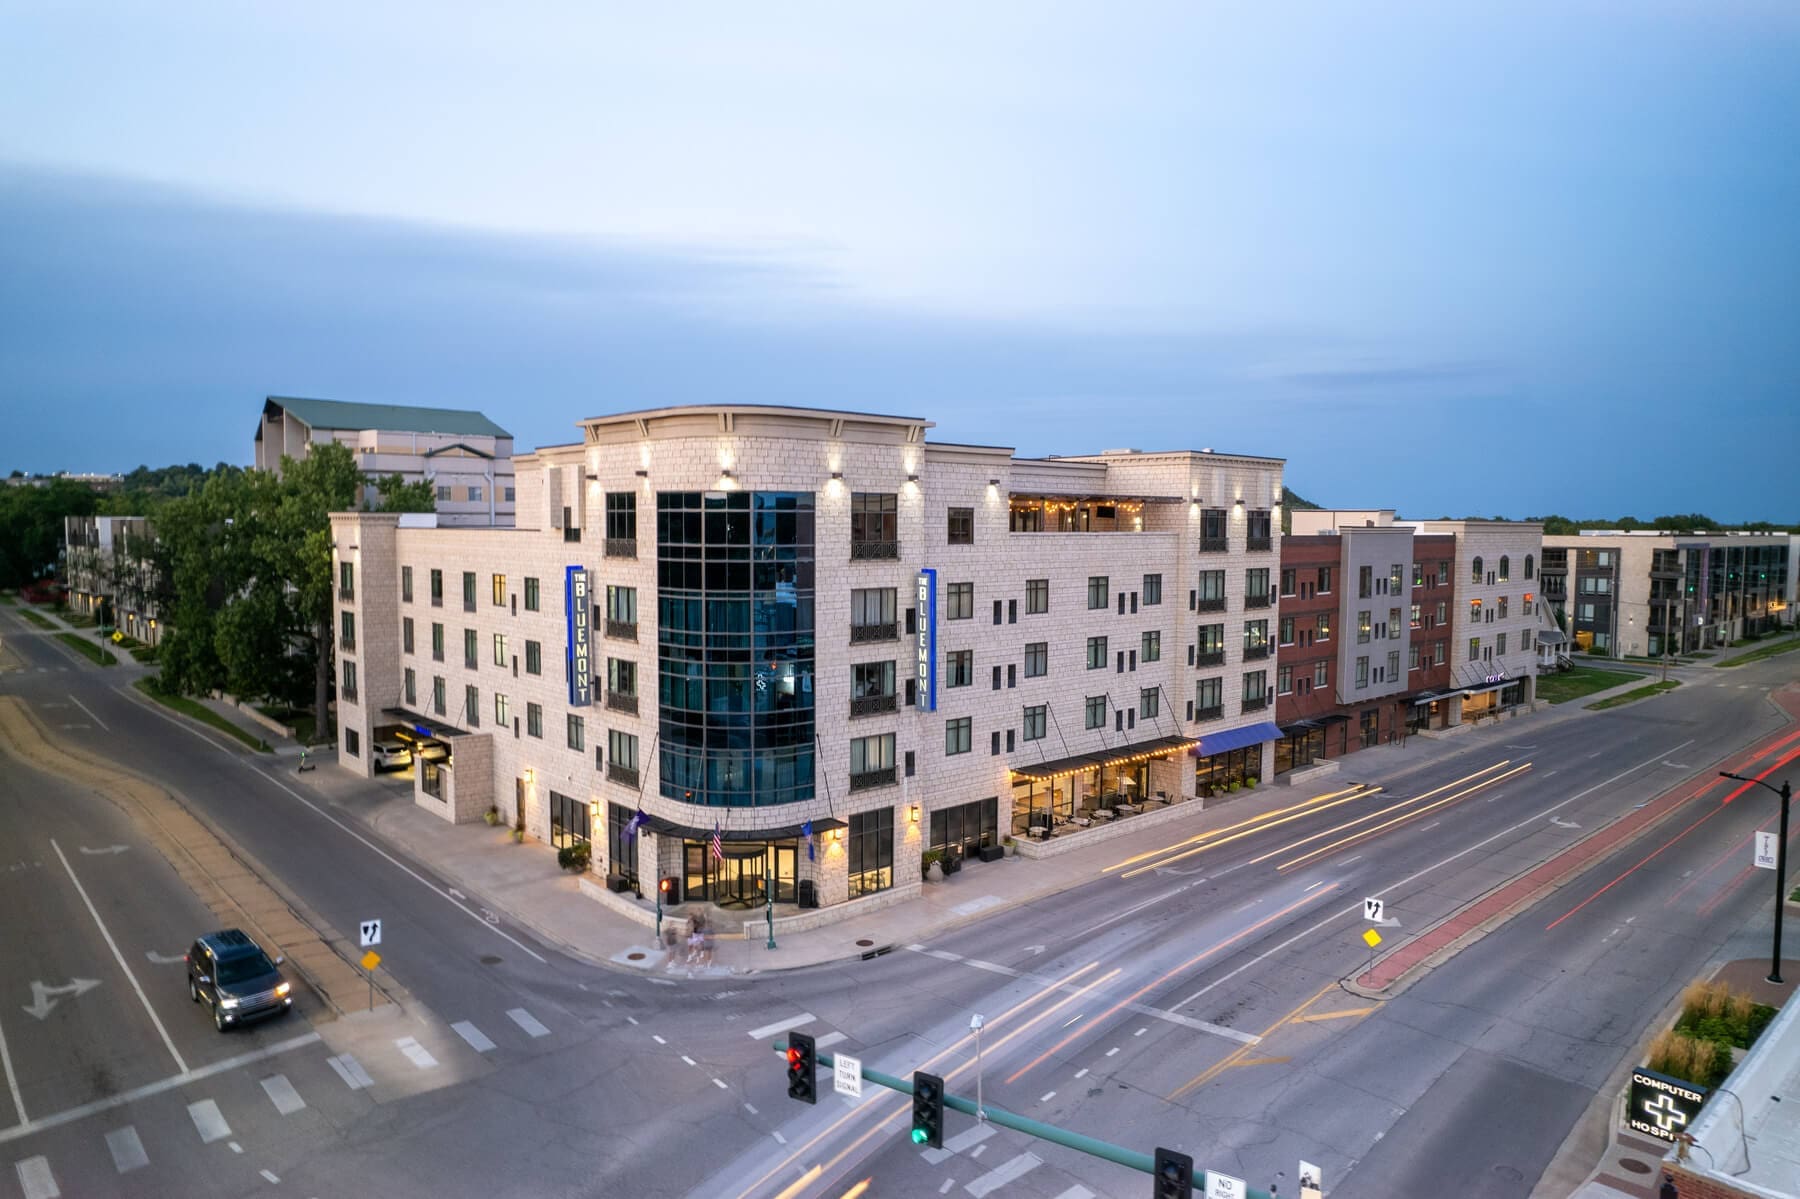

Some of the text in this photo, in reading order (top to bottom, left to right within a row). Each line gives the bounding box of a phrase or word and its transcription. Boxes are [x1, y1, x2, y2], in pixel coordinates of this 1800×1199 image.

[575, 582, 588, 702] BLUEMONT
[918, 586, 928, 707] BLUEMONT
[839, 1056, 855, 1070] LEFT
[839, 1069, 856, 1081] TURN
[836, 1080, 859, 1094] SIGNAL
[1633, 1074, 1703, 1102] COMPUTER
[1631, 1119, 1679, 1141] HOSPI
[1217, 1177, 1232, 1190] NO
[1214, 1189, 1235, 1199] RIGHT
